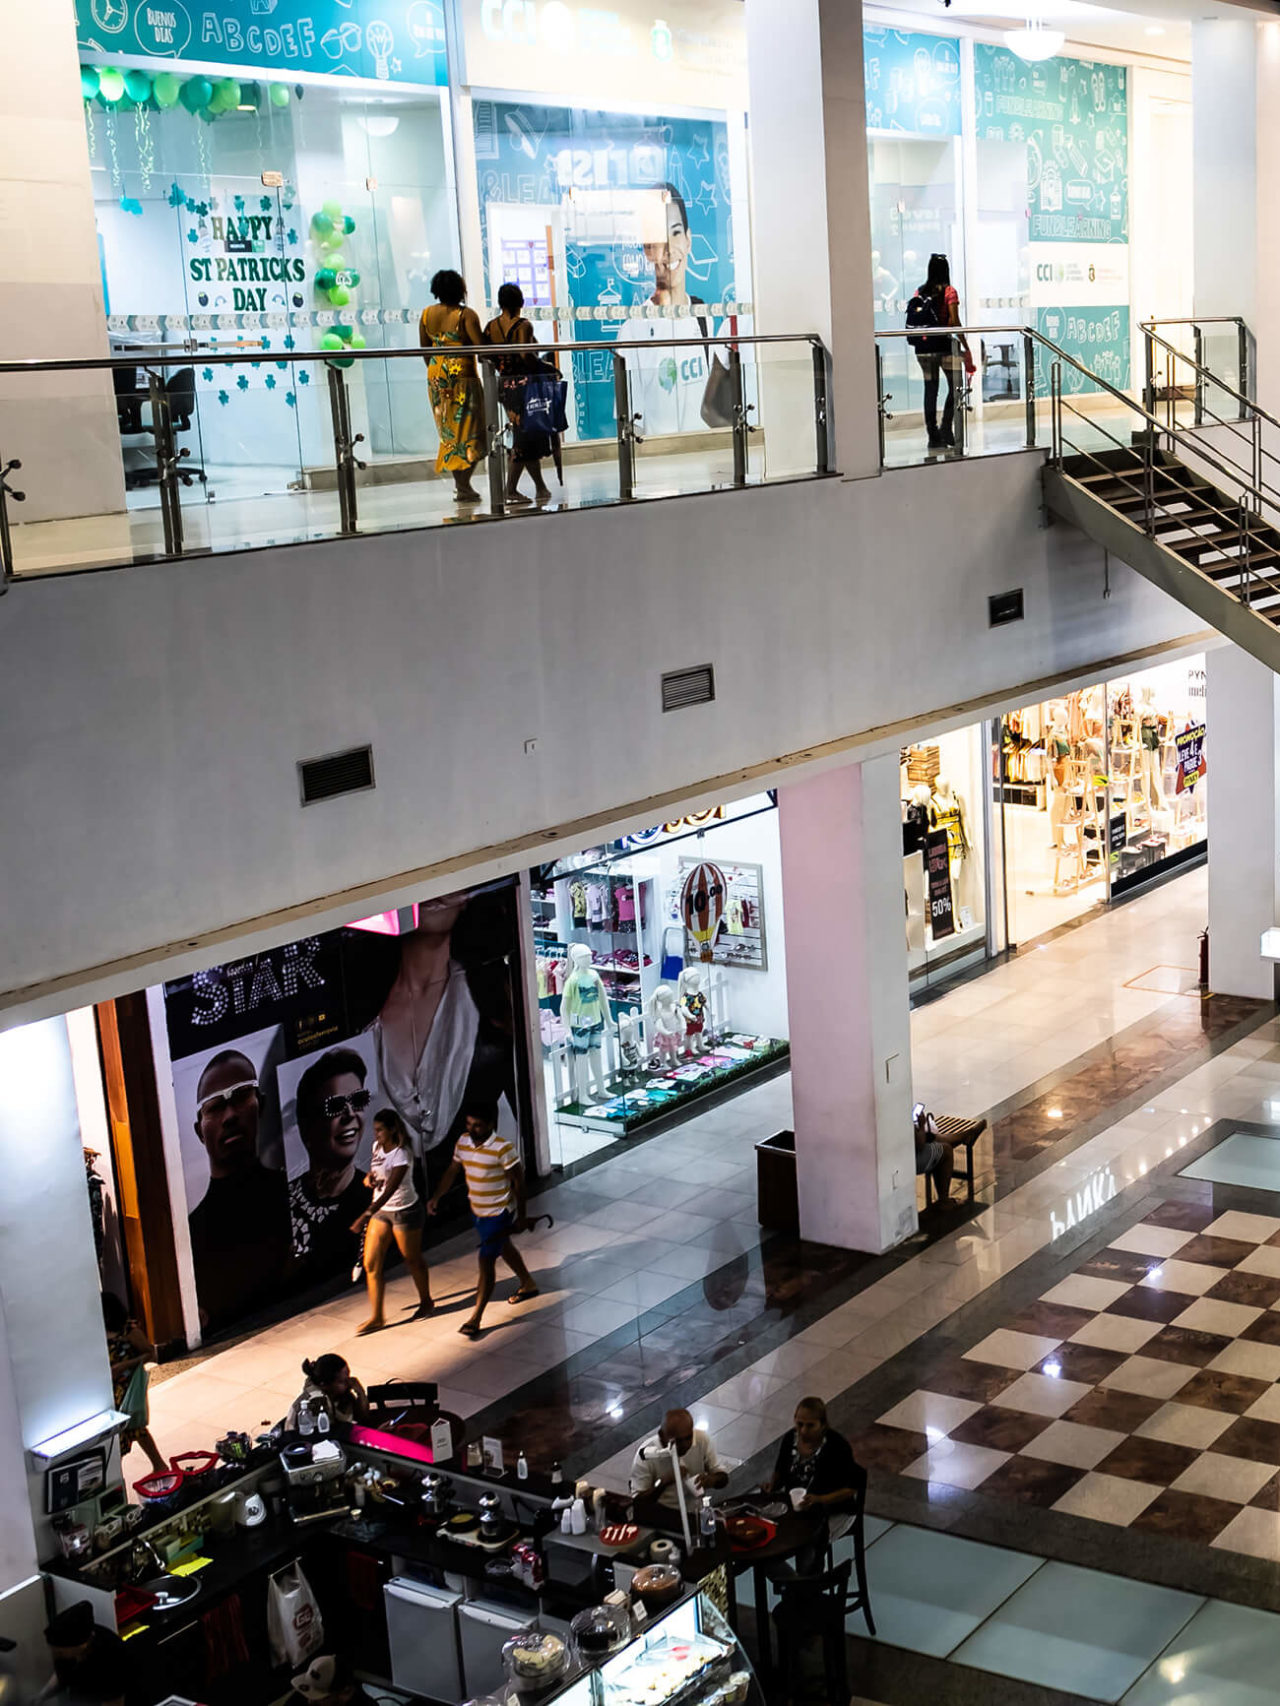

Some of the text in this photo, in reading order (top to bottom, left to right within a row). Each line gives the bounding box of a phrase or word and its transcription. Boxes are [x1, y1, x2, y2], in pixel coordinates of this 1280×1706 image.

[147, 8, 177, 28] BUENOS
[202, 12, 315, 58] ABCDEF
[211, 216, 272, 240] HAPPY
[190, 257, 306, 282] ST PATRICKS
[1036, 263, 1053, 282] CCI
[232, 287, 268, 312] DAY
[681, 356, 703, 382] CCI
[932, 898, 952, 918] 50%
[191, 938, 325, 1025] STAR
